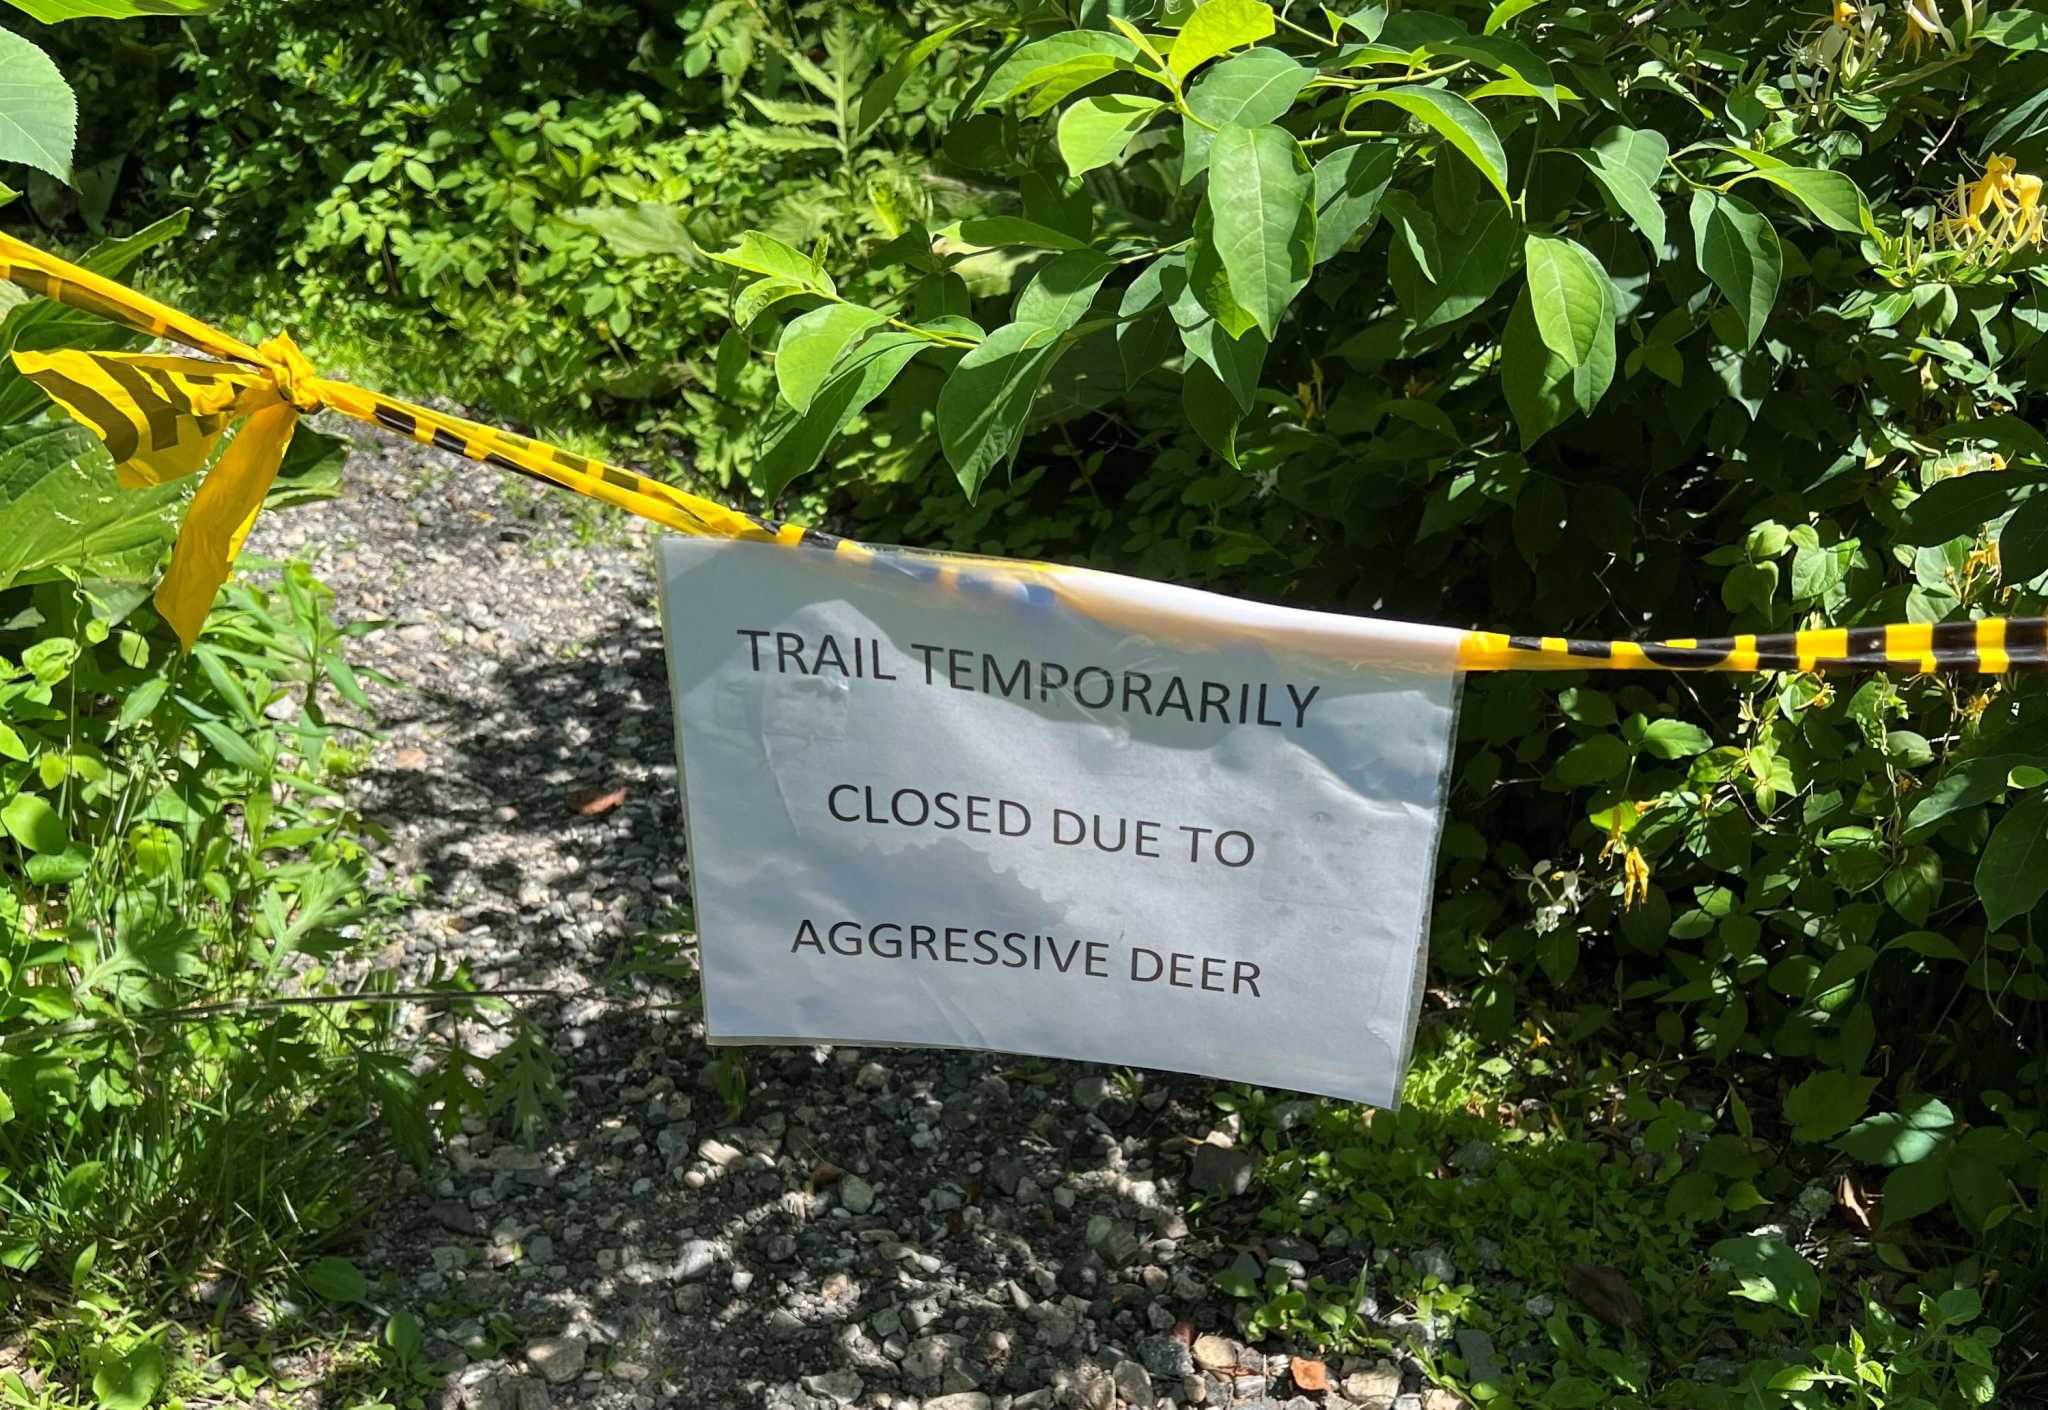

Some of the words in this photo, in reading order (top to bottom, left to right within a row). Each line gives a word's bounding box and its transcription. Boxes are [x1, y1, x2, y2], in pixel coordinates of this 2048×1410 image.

[736, 629, 898, 682] TRAIL
[910, 643, 1321, 730] TEMPORARILY
[827, 783, 1032, 838] CLOSED
[1053, 807, 1162, 859] DUE
[1178, 825, 1256, 868] TO
[790, 919, 1110, 978] AGGRESSIVE
[1130, 947, 1262, 999] DEER
